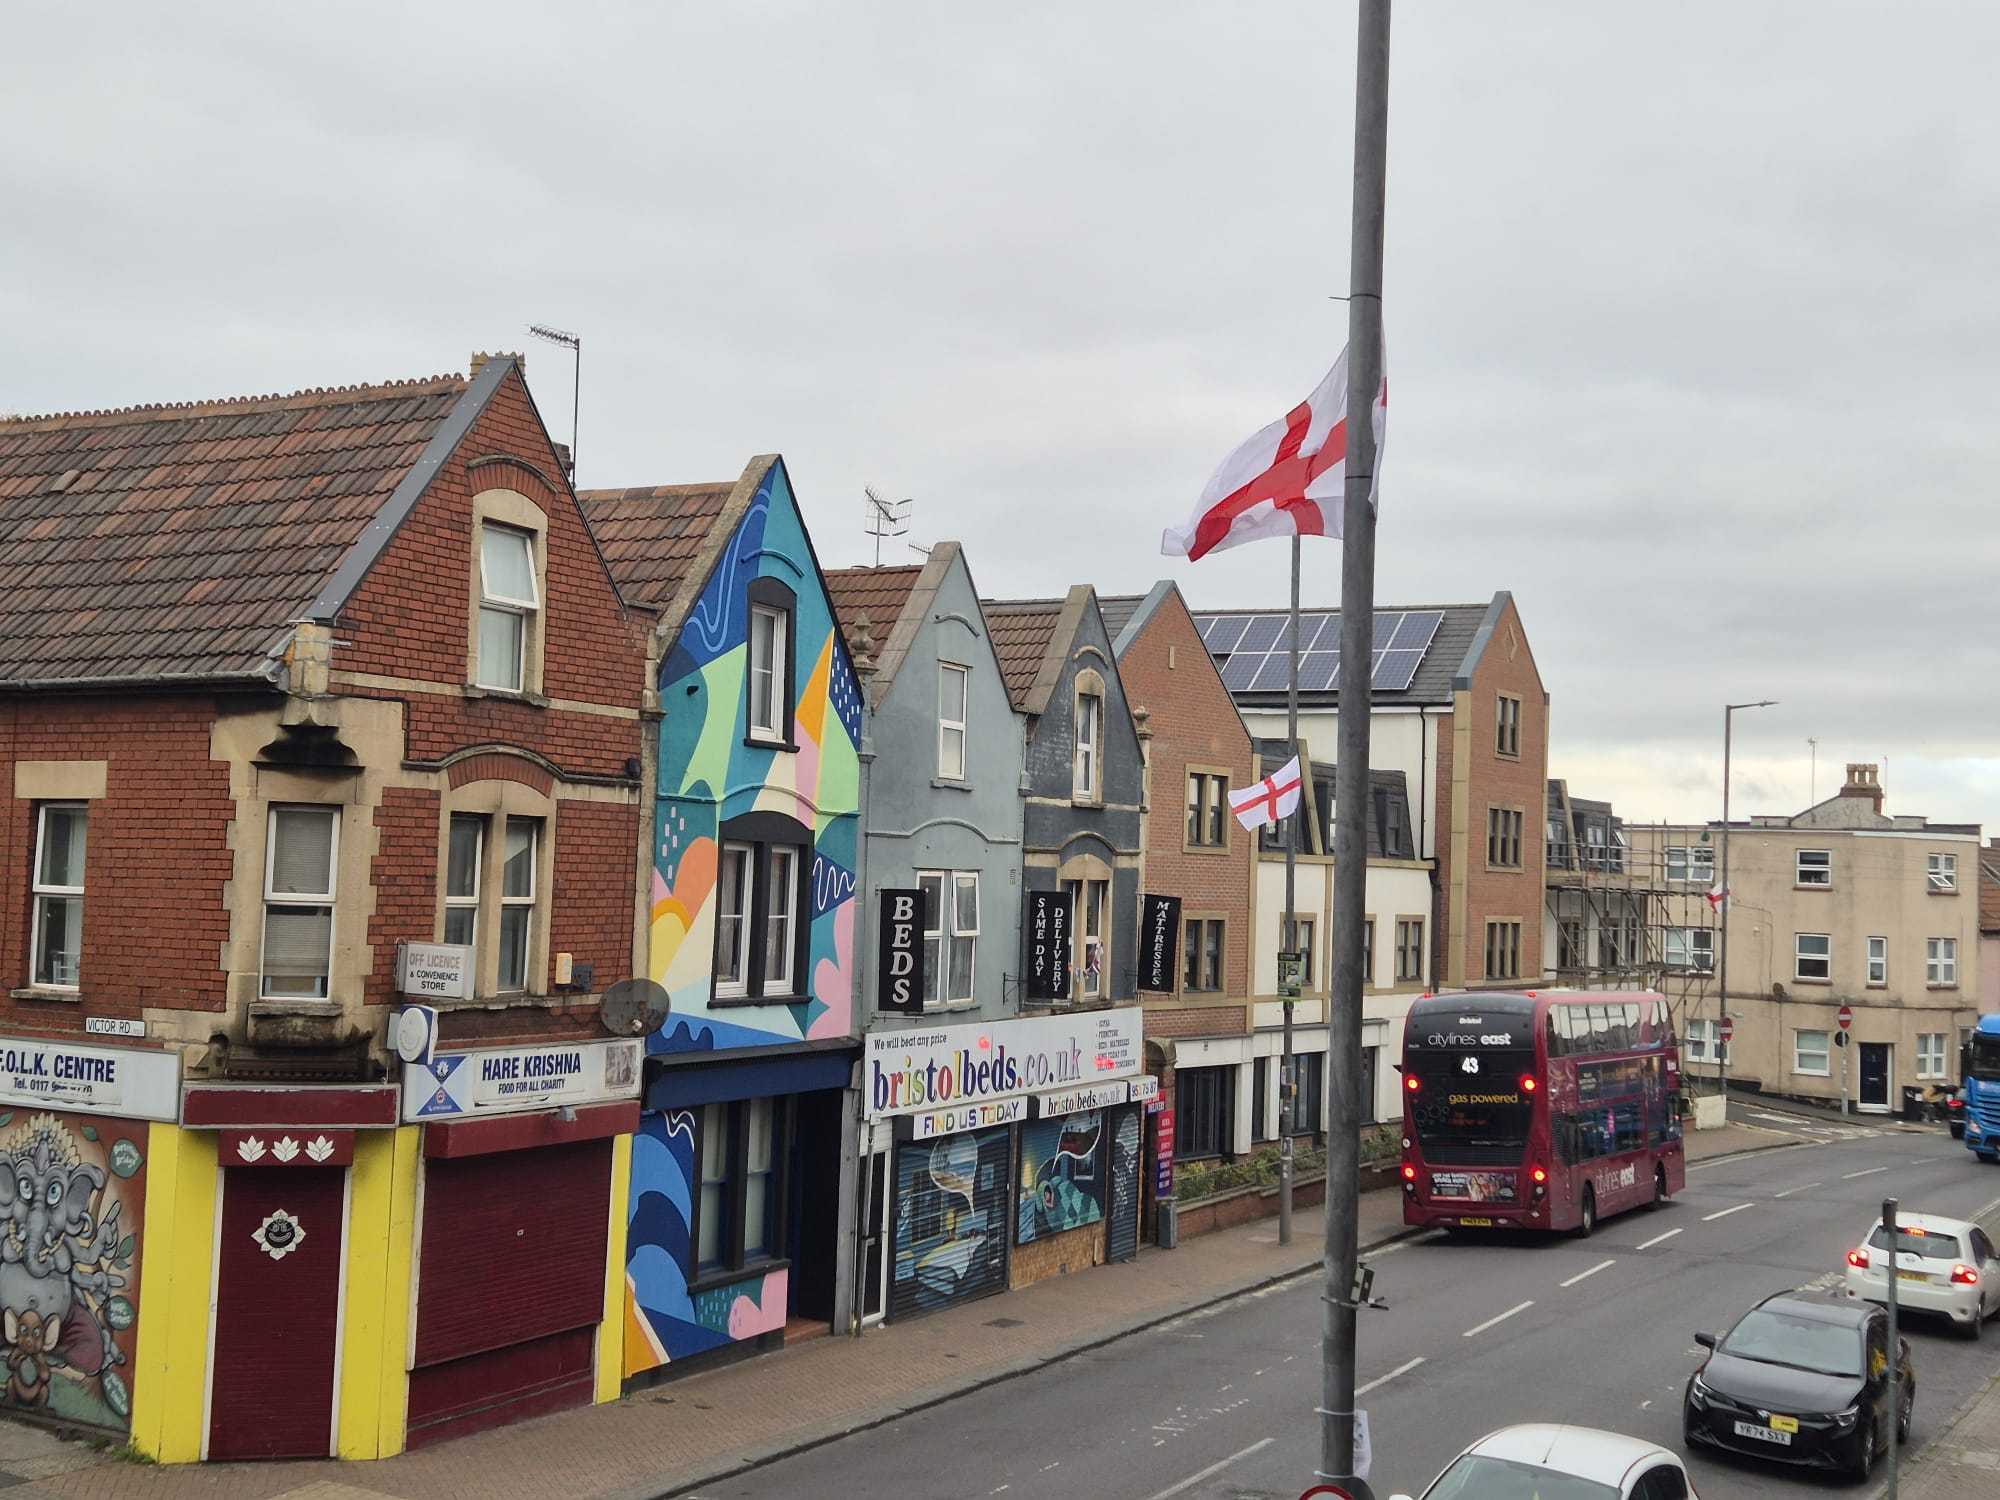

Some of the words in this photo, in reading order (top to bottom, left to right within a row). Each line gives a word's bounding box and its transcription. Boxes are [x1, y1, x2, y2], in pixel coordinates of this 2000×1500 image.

[1035, 897, 1047, 940] SAME
[890, 896, 914, 1004] BEDS
[1052, 907, 1064, 992] DELIVERY
[1151, 901, 1170, 986] MATTRESSES
[409, 952, 425, 967] OFF
[427, 953, 461, 970] LICENCE
[1035, 944, 1045, 977] DAY
[416, 970, 459, 981] CONVENIENCE
[421, 980, 446, 991] STORE
[87, 1019, 116, 1033] VICTOR
[119, 1021, 131, 1034] RD
[1427, 1032, 1477, 1047] citylines
[1480, 1032, 1512, 1046] east
[874, 1039, 885, 1050] We
[886, 1037, 899, 1048] will
[900, 1035, 916, 1048] beat
[917, 1036, 929, 1047] any
[930, 1033, 947, 1047] price
[54, 1054, 116, 1083] CENTRE
[482, 1056, 520, 1081] HARE
[523, 1052, 581, 1078] KRISHNA
[872, 1037, 1081, 1112] bristolbeds.co.uk
[14, 1077, 27, 1090] Tel.
[30, 1079, 49, 1092] 0117
[498, 1083, 515, 1095] FOOD
[515, 1081, 528, 1093] FOR
[528, 1080, 539, 1091] ALL
[540, 1078, 566, 1090] CHARITY
[1448, 1094, 1468, 1105] gas
[1470, 1092, 1518, 1105] powered
[1047, 1087, 1121, 1115] bristolbeds.co.uk
[924, 1112, 955, 1136] FIND
[959, 1108, 977, 1129] US
[980, 1101, 1019, 1124] TODAY
